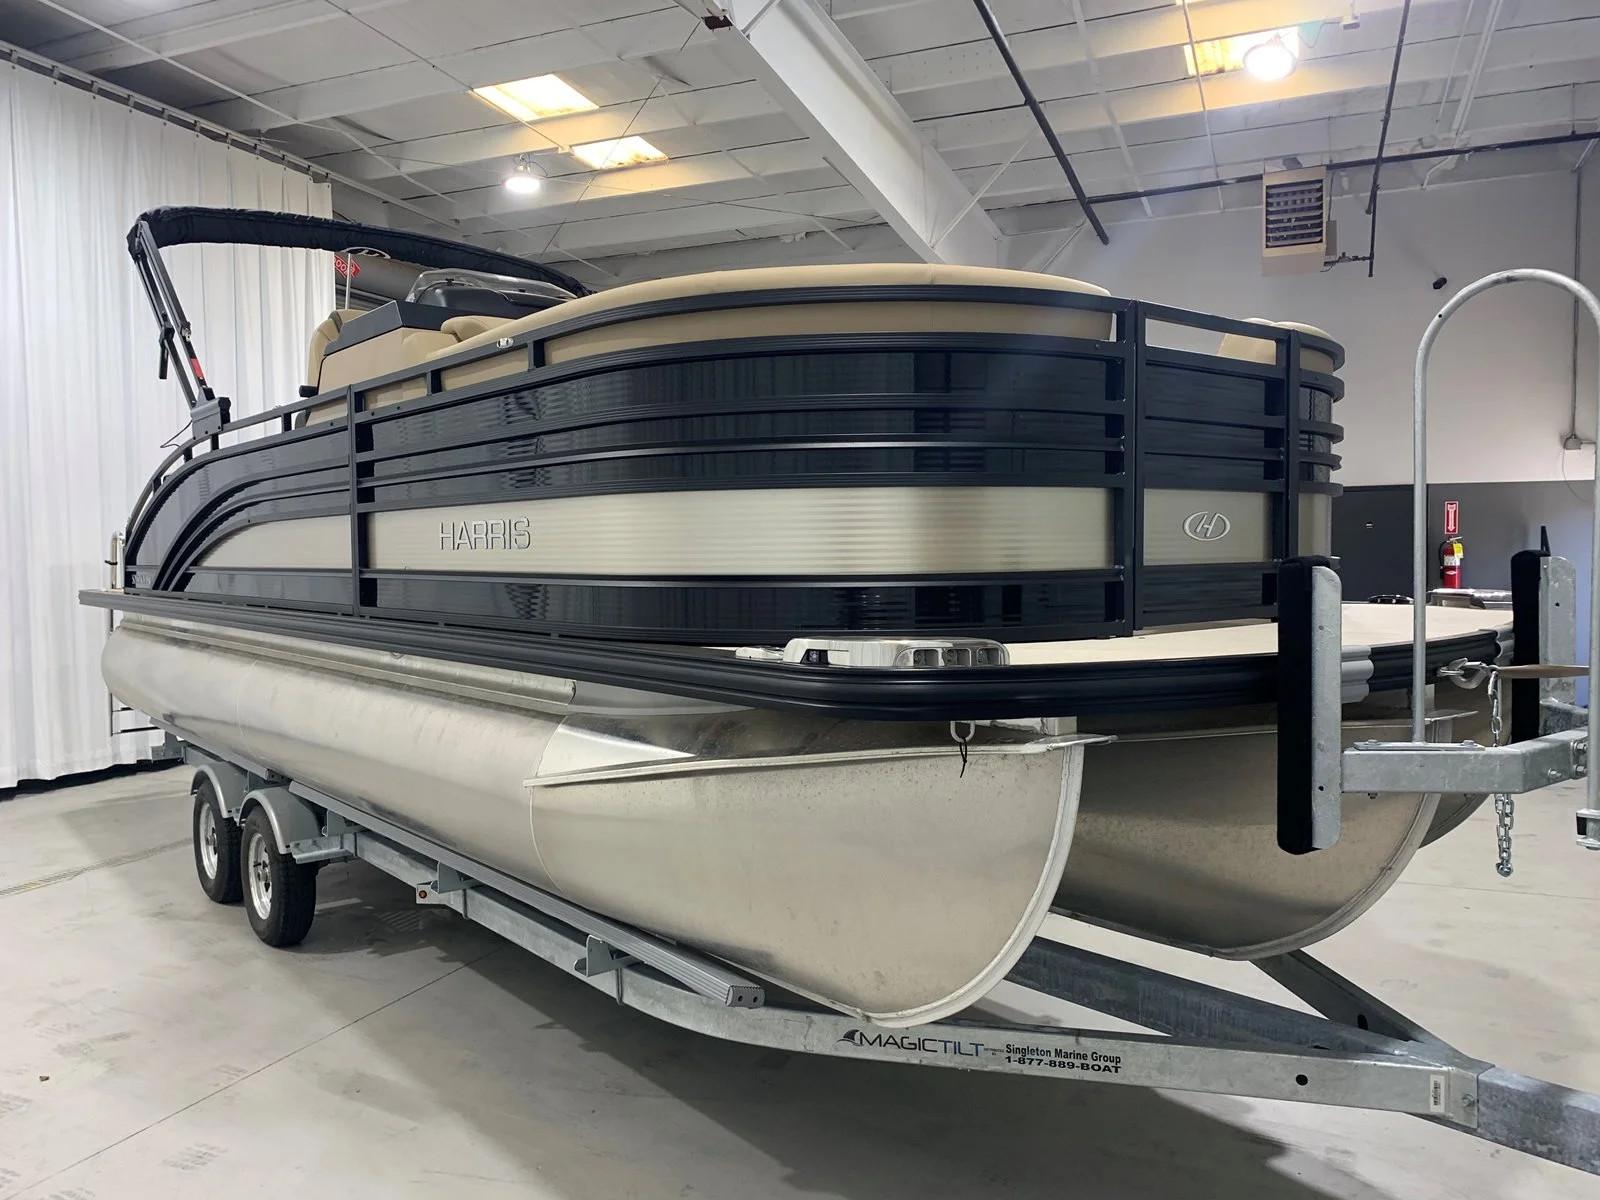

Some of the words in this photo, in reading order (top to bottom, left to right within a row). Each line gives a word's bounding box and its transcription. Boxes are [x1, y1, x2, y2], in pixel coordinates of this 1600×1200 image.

[440, 516, 531, 551] HARRIS
[860, 1031, 984, 1057] MAGICTILT
[1005, 1043, 1051, 1058] Singleton
[1054, 1048, 1088, 1061] Marine
[1091, 1051, 1121, 1065] Group
[1005, 1056, 1121, 1073] 1-877-889-BOAT
